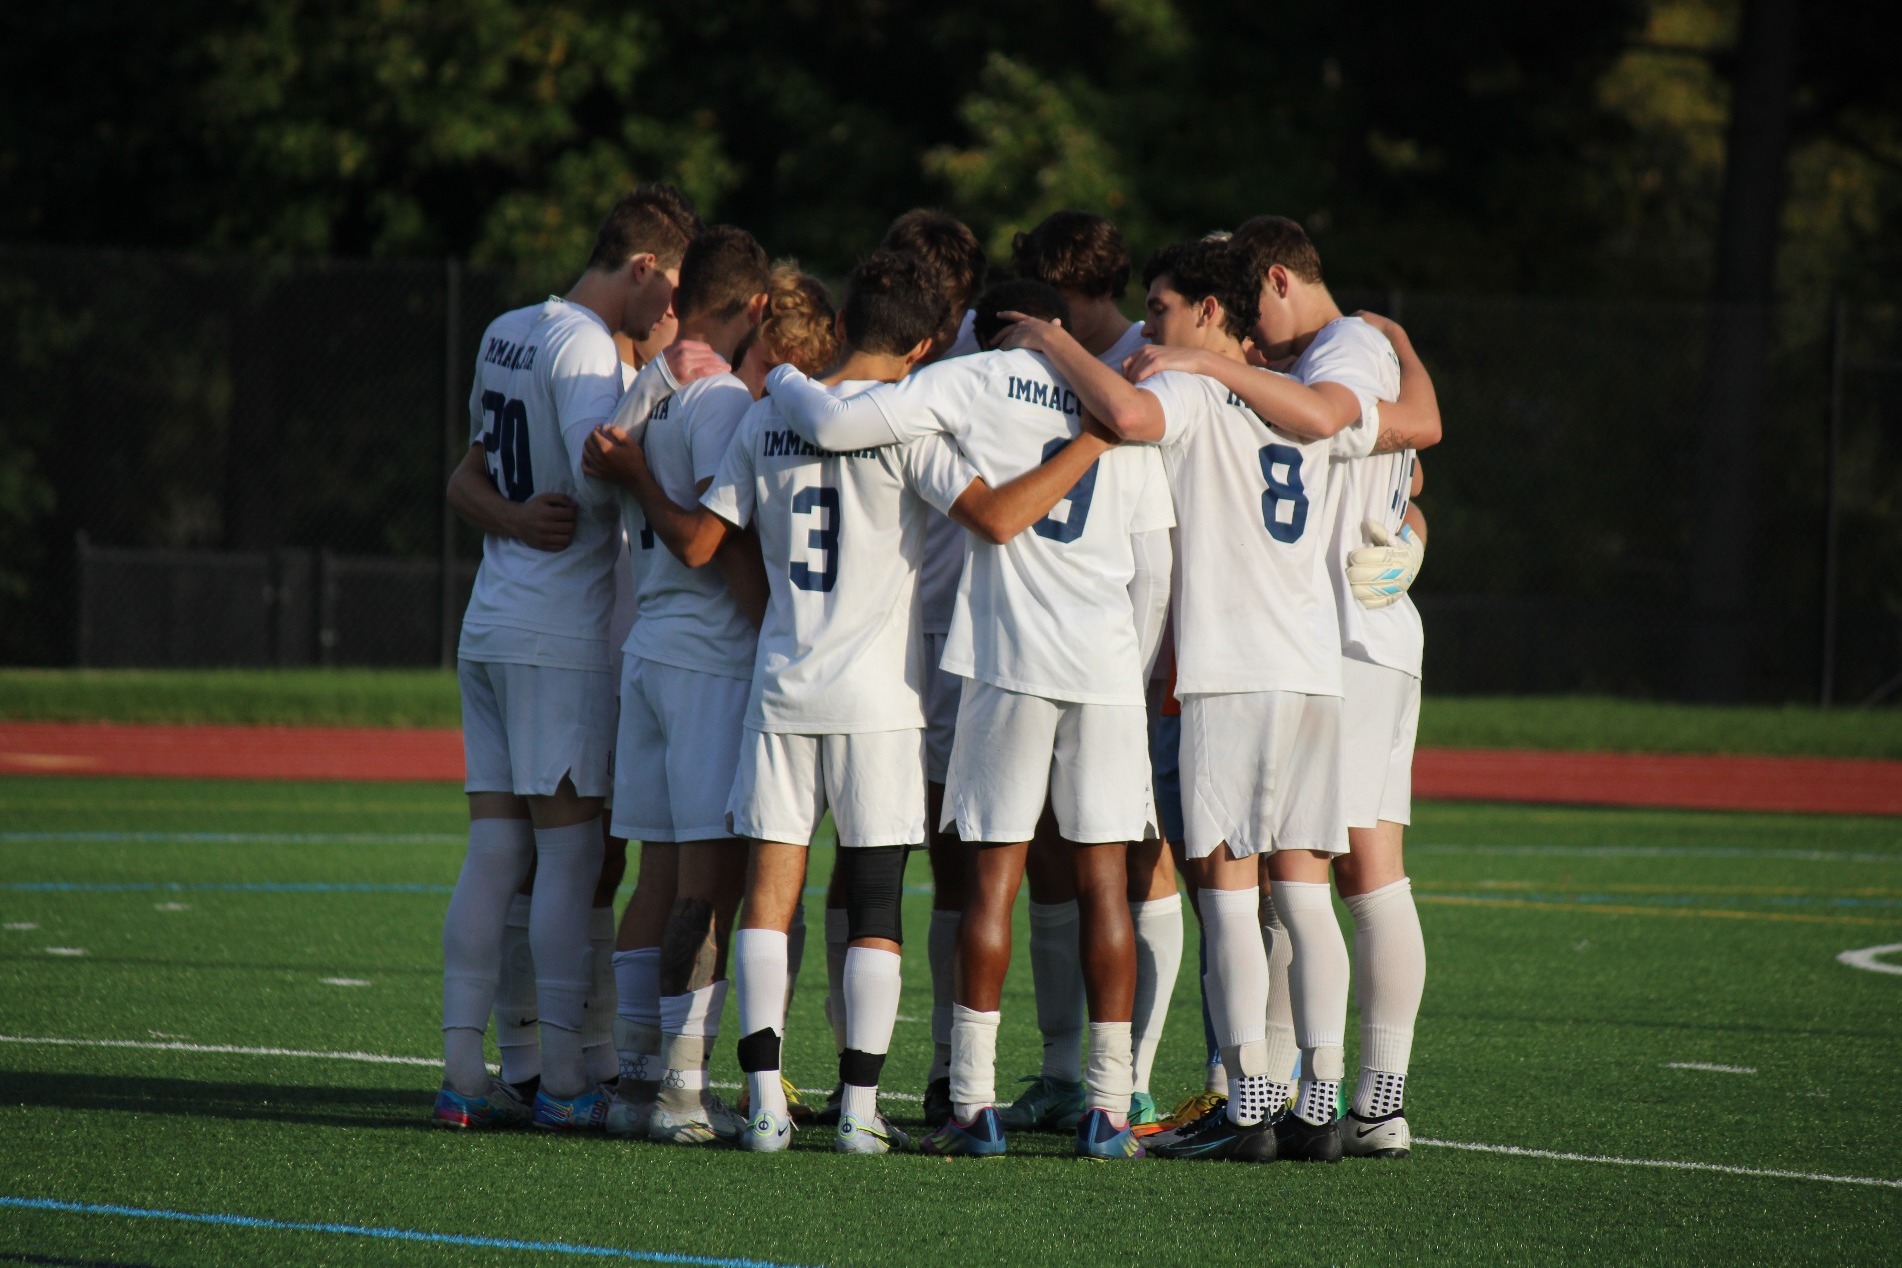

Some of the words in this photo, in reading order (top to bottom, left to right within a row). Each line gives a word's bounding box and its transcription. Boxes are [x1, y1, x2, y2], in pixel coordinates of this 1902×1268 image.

[482, 389, 535, 503] 20
[1258, 442, 1310, 544] 8
[789, 486, 840, 593] 3
